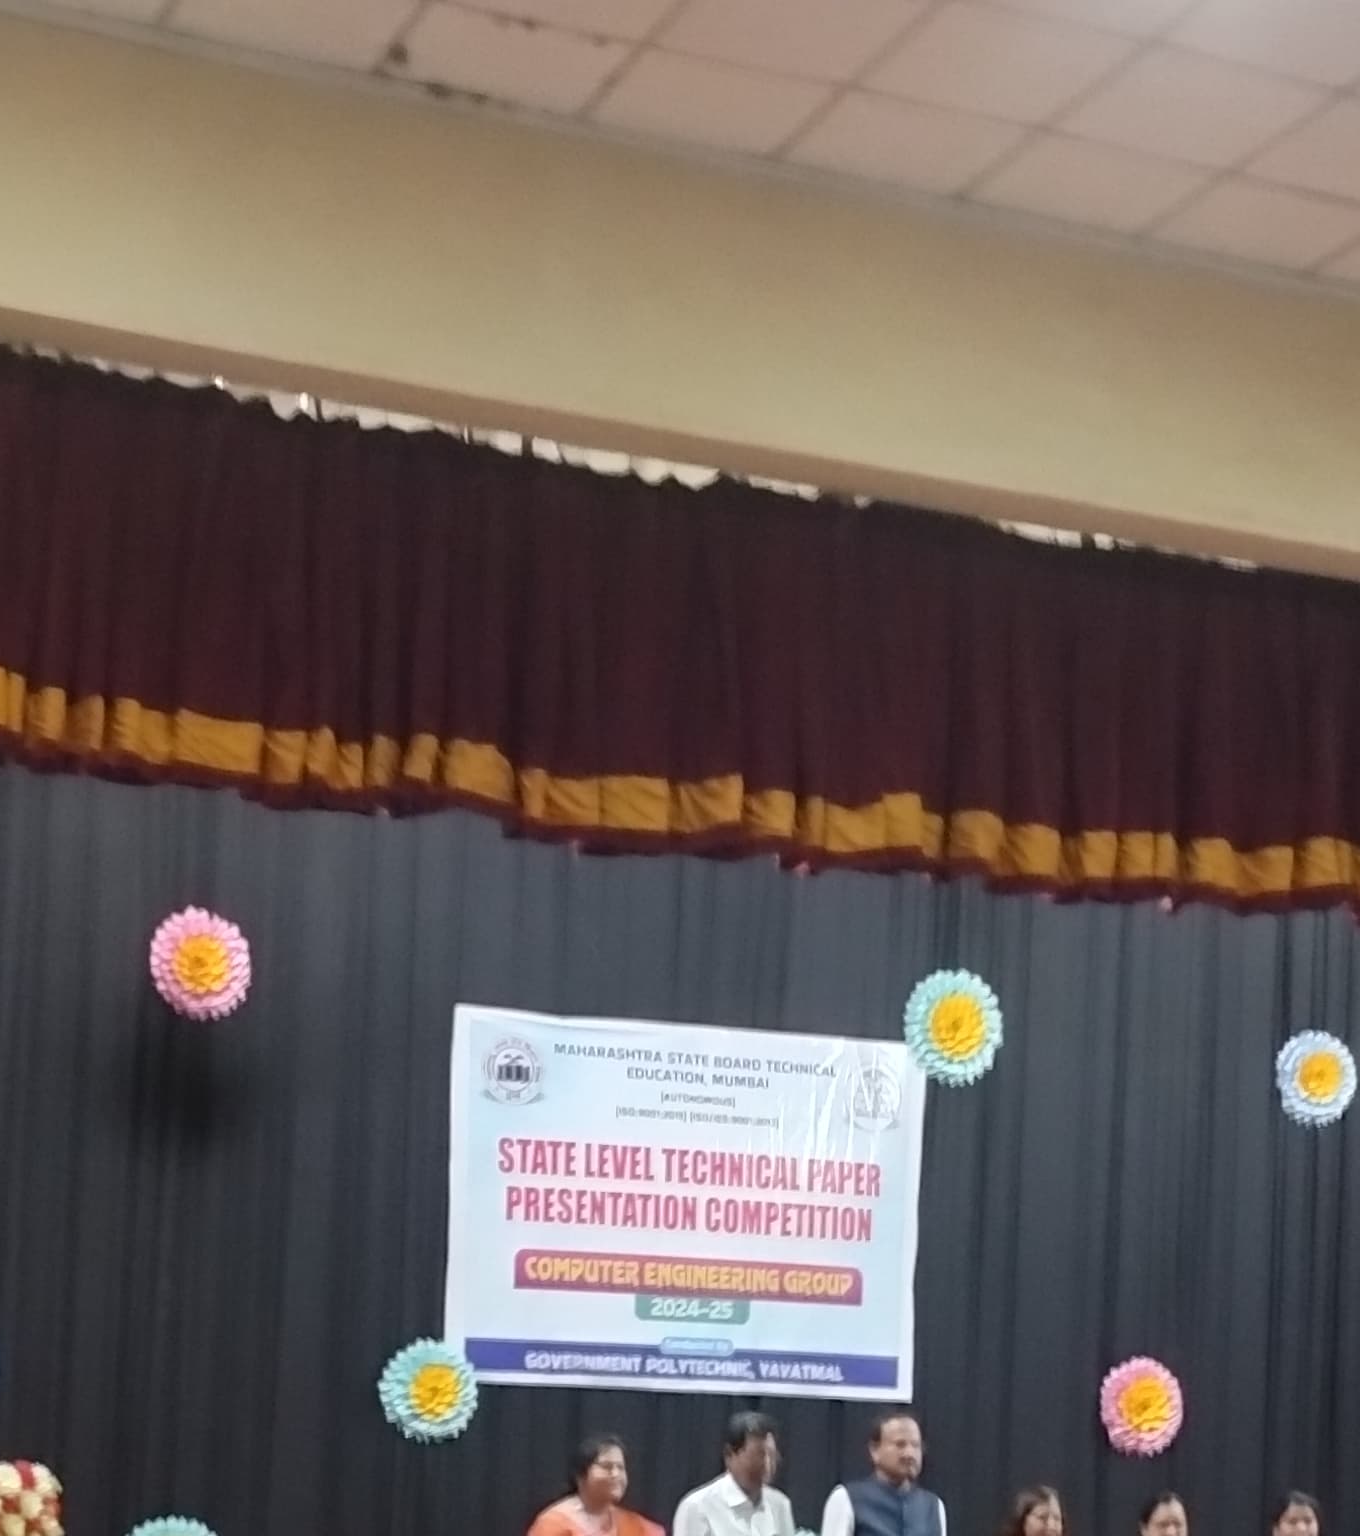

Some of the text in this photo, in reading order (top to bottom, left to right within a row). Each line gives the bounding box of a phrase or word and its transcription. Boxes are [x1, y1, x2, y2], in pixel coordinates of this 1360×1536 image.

[554, 1043, 837, 1077] MAHARASHTRA STATE BOARD TECHNICAL
[626, 1067, 769, 1089] EDUCATION, MUMBAI
[498, 1137, 881, 1197] STATE LEVEL TECHNICAL PAPER
[505, 1185, 872, 1241] PRESENTATION COMPETITION
[524, 1256, 853, 1297] COMPUTER ENGINEERING GROUP
[650, 1297, 734, 1319] 2024-25
[524, 1351, 642, 1373] GOVERNMENT
[759, 1361, 844, 1382] YAVATMAL
